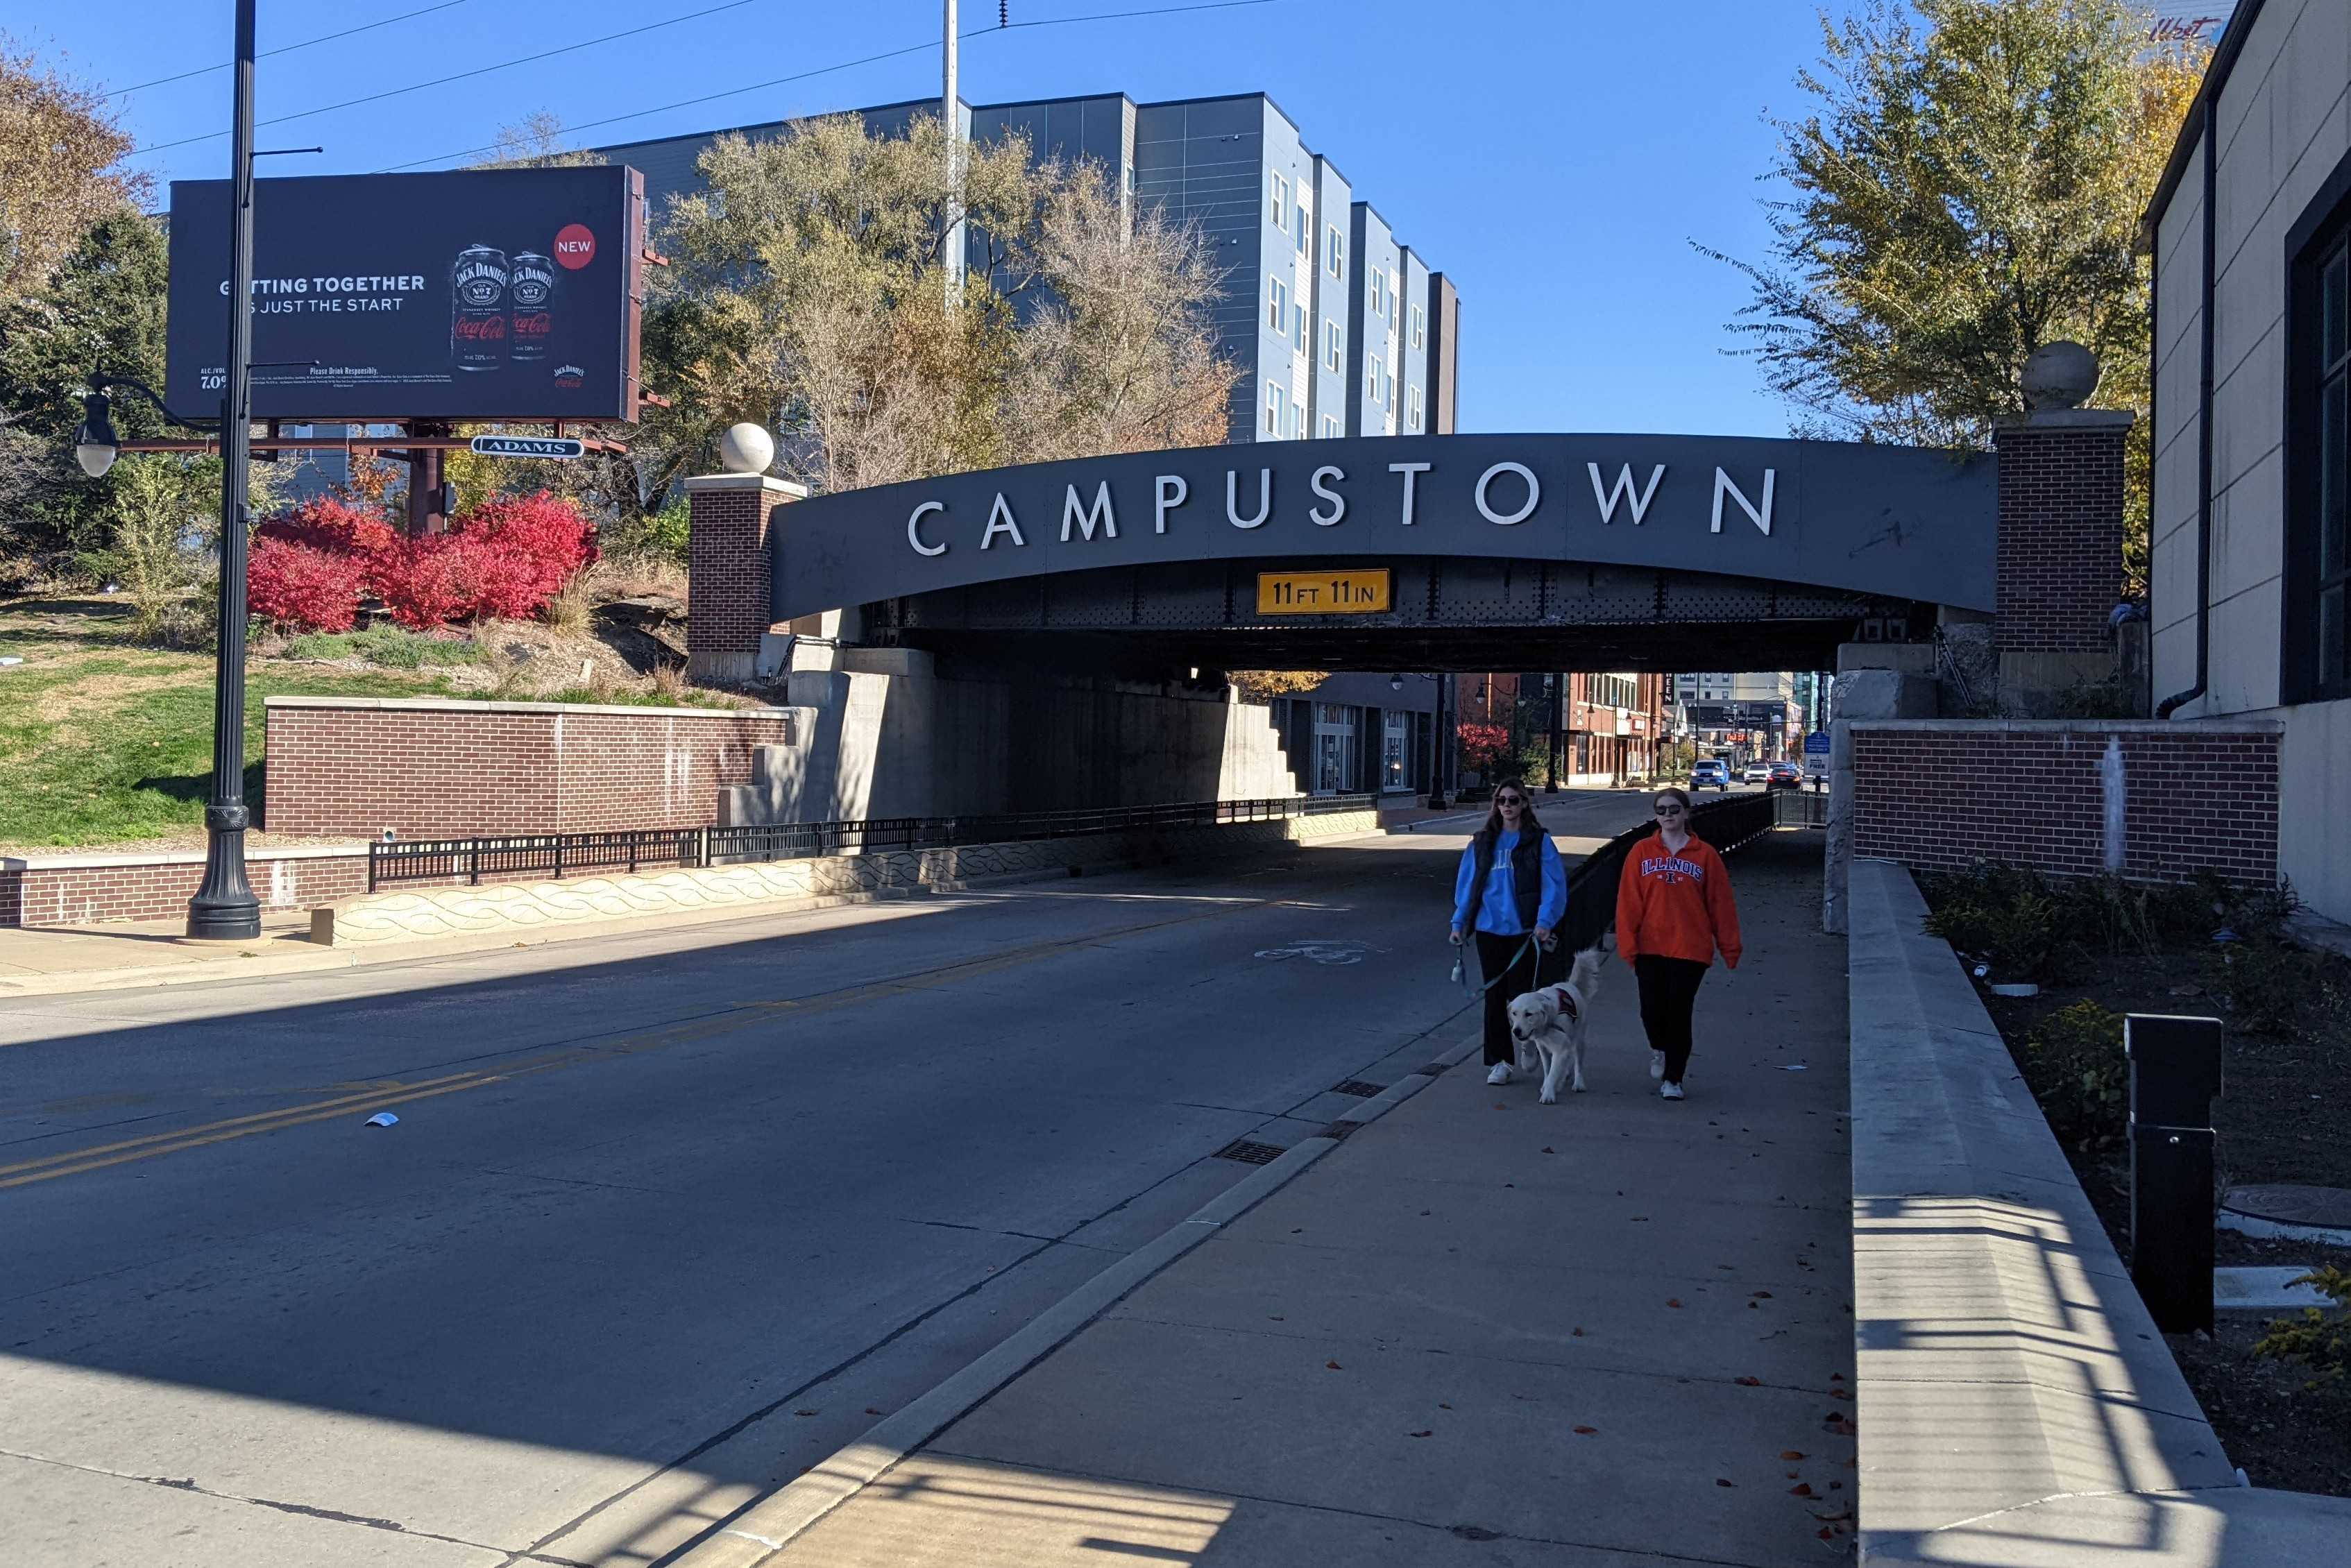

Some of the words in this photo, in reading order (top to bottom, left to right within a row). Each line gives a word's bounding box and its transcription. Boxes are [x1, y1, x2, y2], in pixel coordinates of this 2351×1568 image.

[558, 241, 591, 253] NEW
[219, 278, 307, 296] GTTING
[313, 275, 425, 292] TOGETHER
[457, 266, 475, 288] JACK
[475, 262, 507, 287] DANIEL'S
[525, 266, 552, 289] DANIEL'S
[260, 300, 304, 314] JUST
[307, 299, 342, 312] THE
[347, 298, 403, 312] START
[345, 367, 378, 375] Responsibly.
[554, 366, 566, 377] JACK
[489, 441, 566, 453] ADAMS
[908, 461, 1775, 556] CAMPUSTOWN
[1273, 582, 1291, 604] 11
[1297, 588, 1320, 604] FT
[1331, 581, 1350, 603] 11
[1355, 587, 1374, 603] IN
[1642, 857, 1704, 882] ILLINOIS
